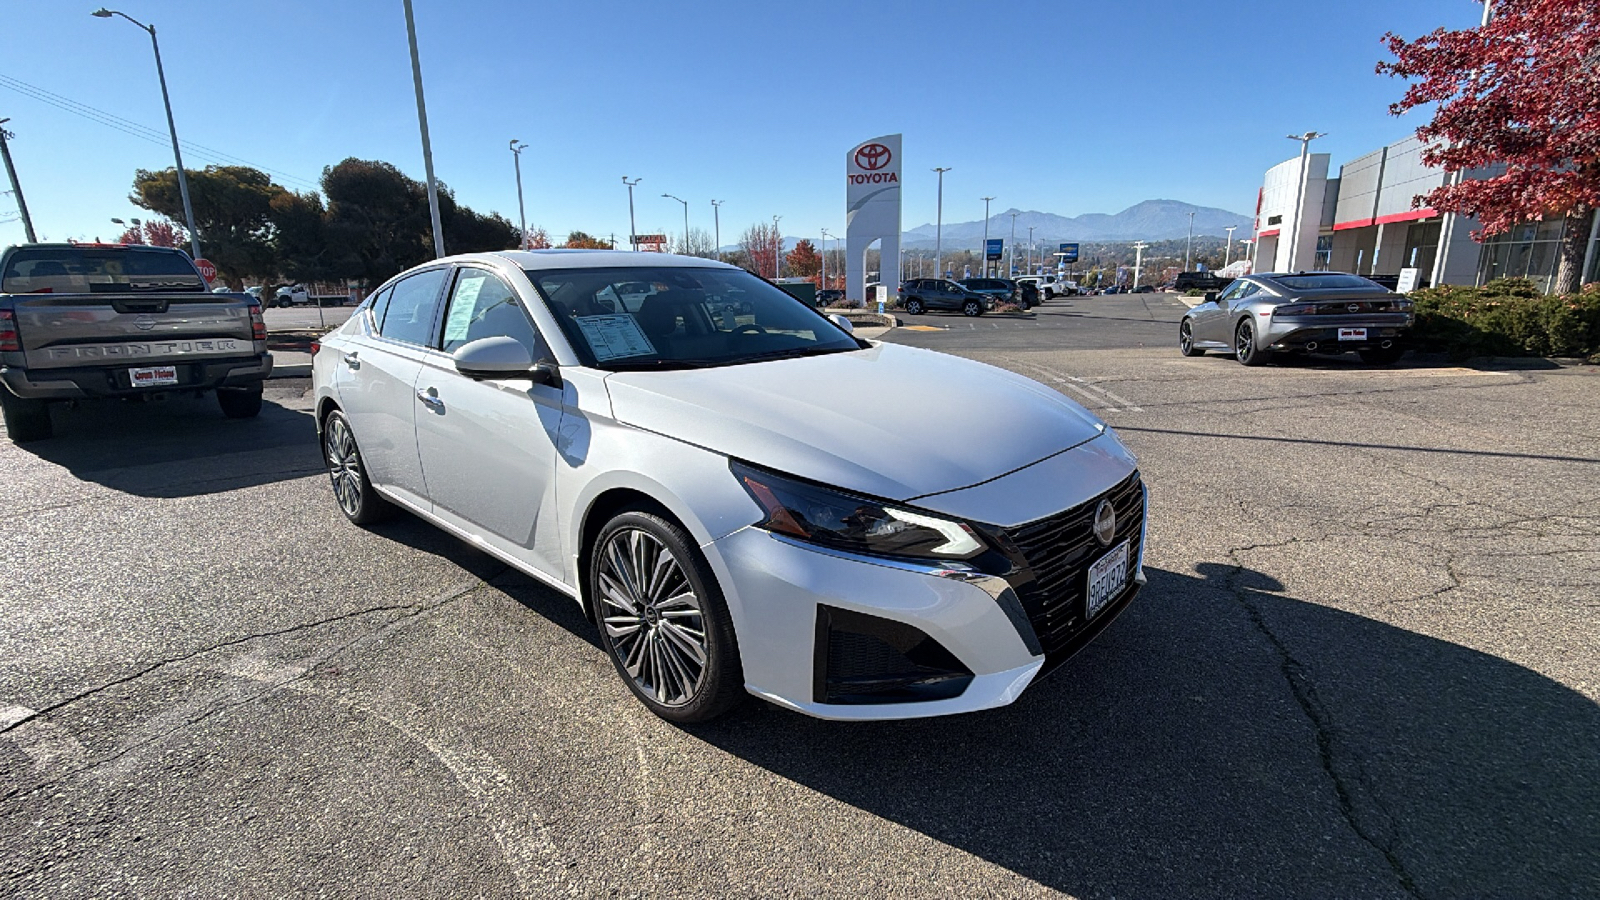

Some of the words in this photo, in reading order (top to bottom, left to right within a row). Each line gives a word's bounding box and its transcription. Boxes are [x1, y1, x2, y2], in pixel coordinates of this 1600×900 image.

[848, 172, 898, 185] TOYOTA
[197, 266, 215, 277] TOP
[50, 340, 236, 359] FRONTIER
